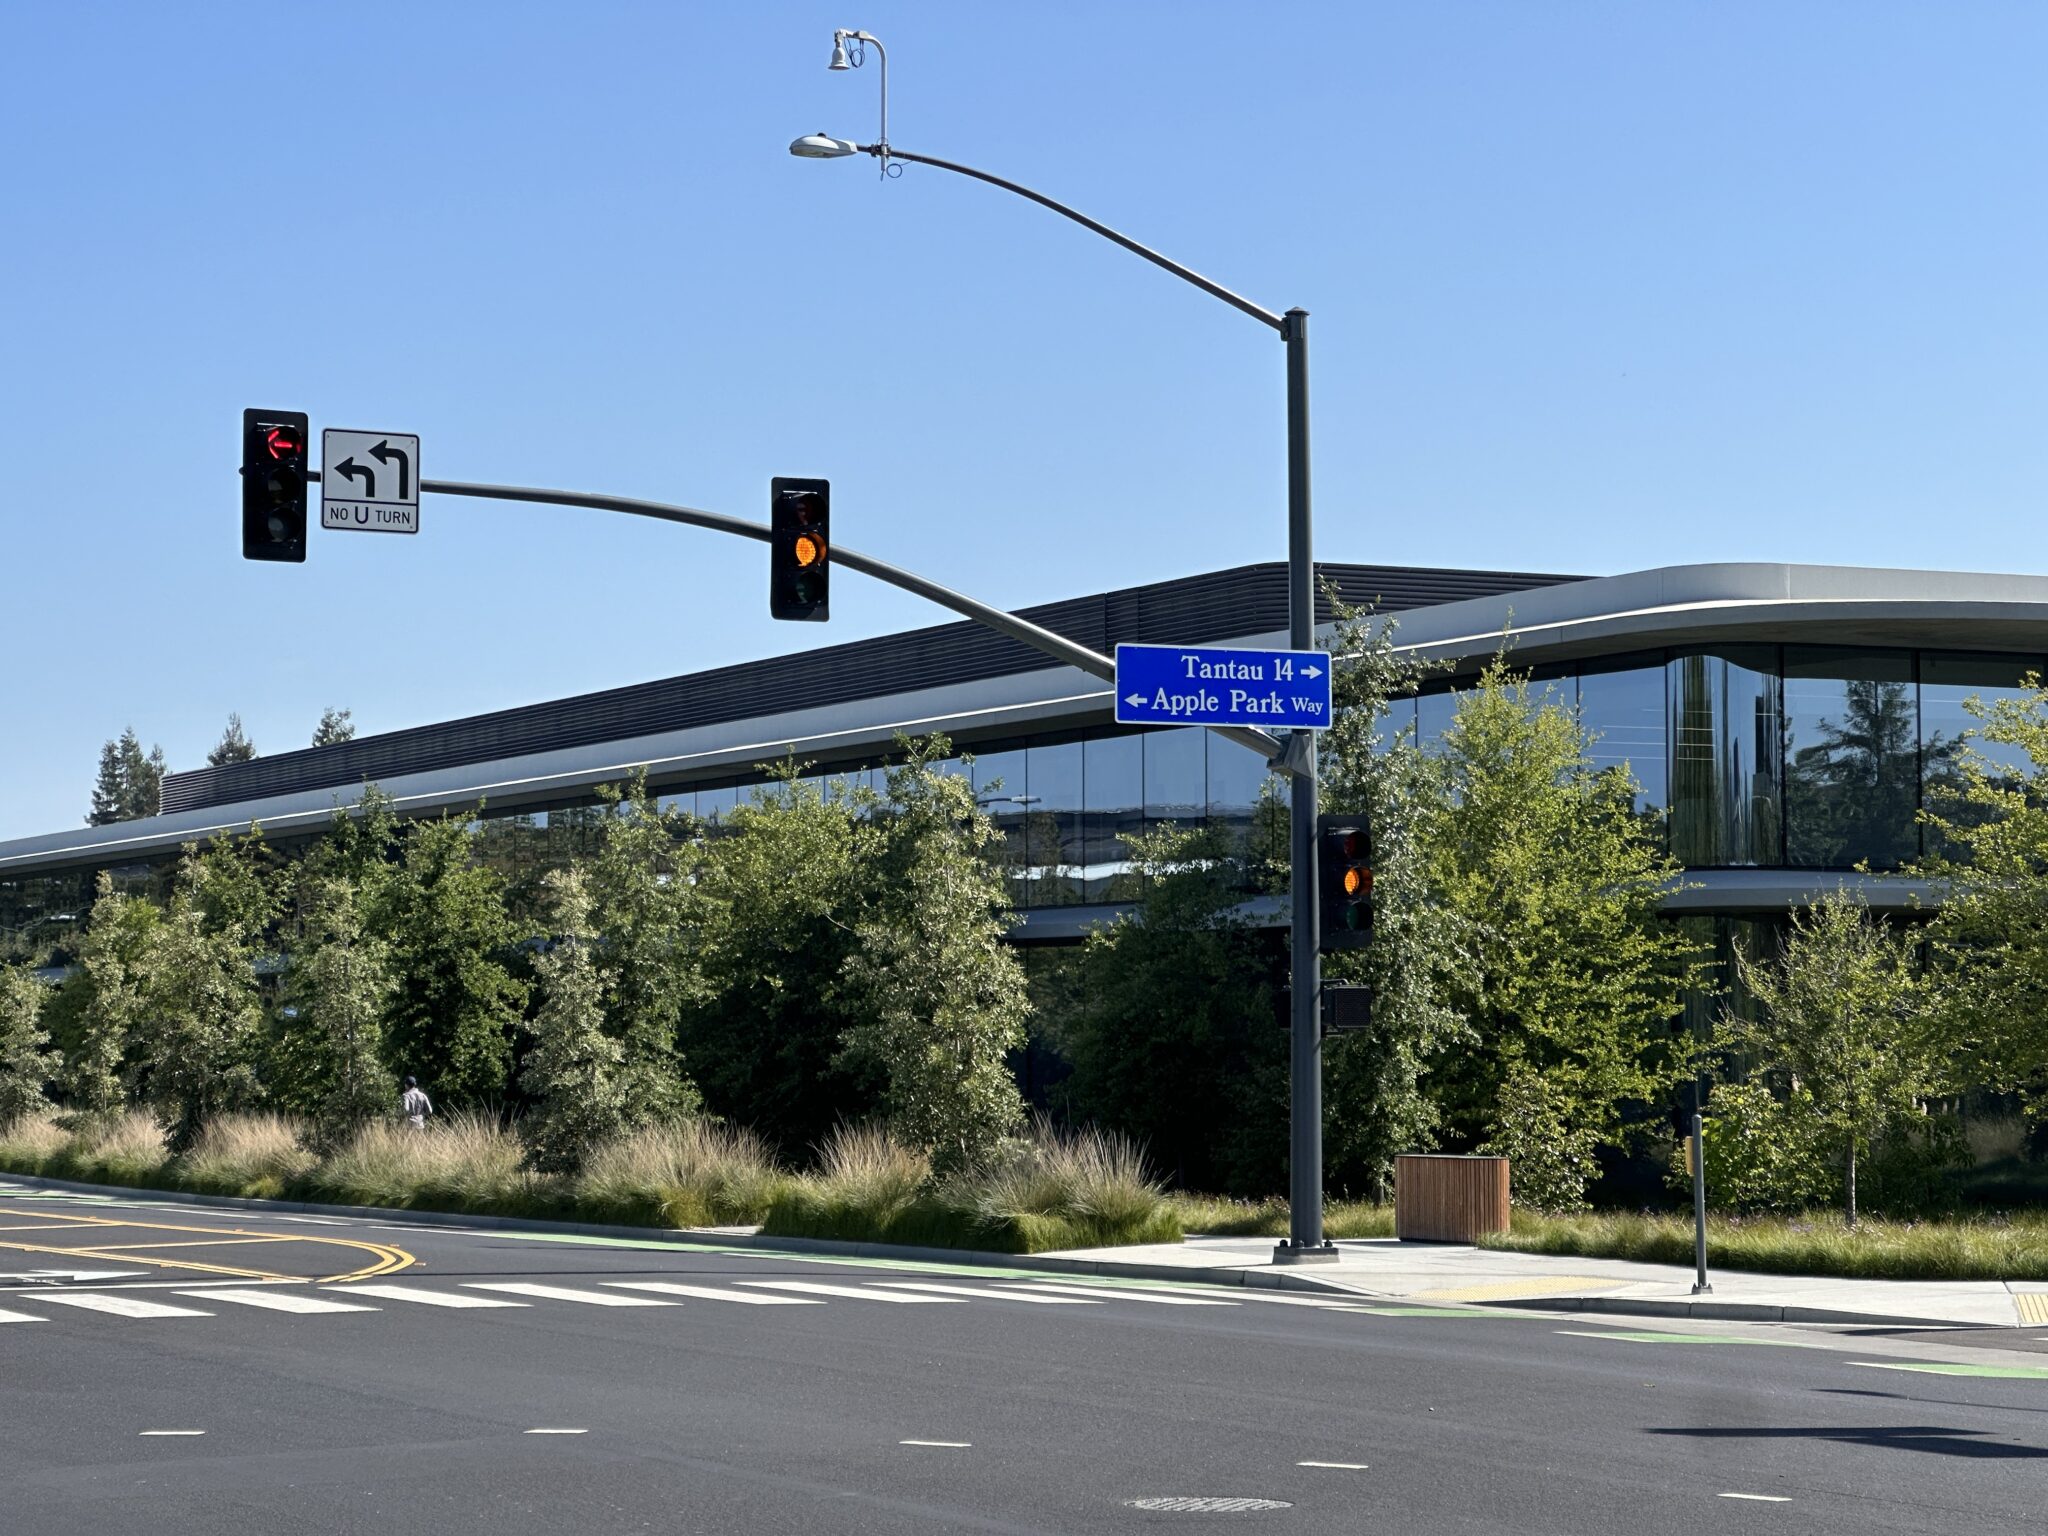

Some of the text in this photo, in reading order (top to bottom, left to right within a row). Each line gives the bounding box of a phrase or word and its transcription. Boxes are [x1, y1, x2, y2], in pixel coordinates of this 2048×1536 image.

[330, 506, 410, 524] NO U TURN
[1181, 655, 1293, 681] Tantau 14
[1150, 687, 1324, 716] Apple Park Way
